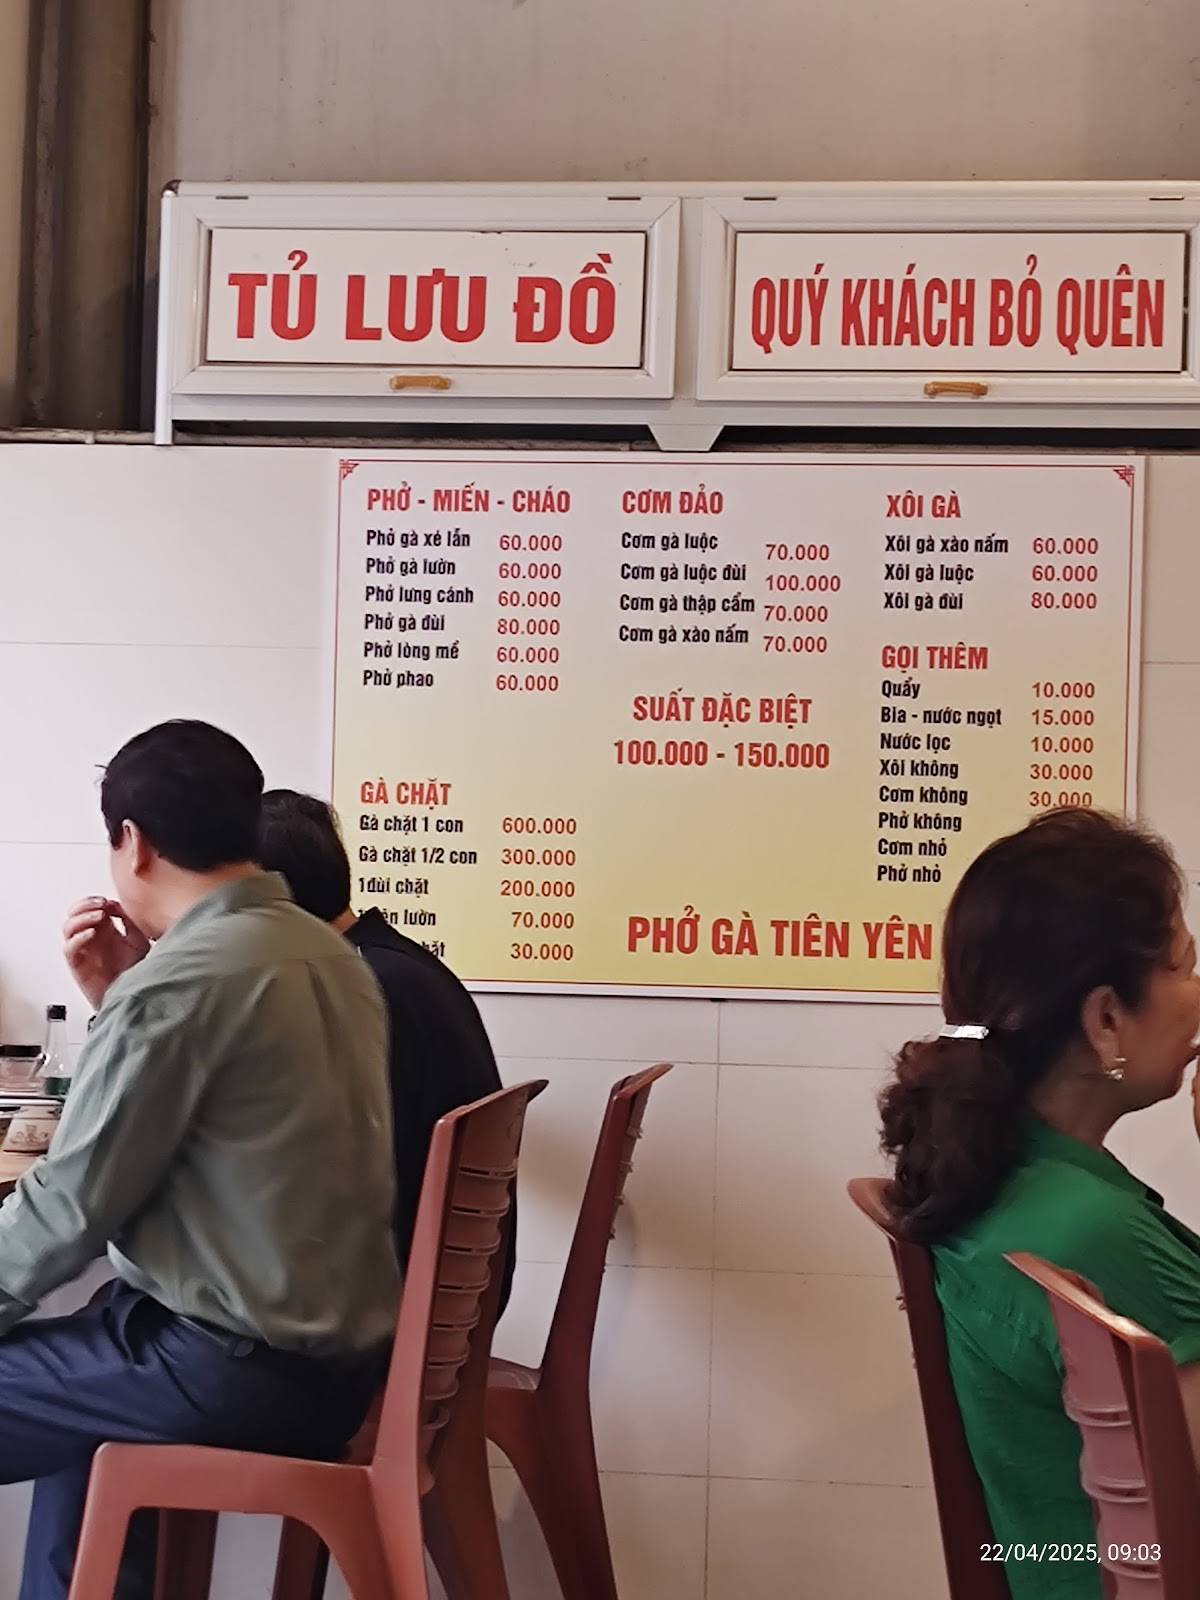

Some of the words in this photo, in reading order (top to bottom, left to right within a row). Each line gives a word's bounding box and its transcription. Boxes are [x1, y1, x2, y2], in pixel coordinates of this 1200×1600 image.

[228, 249, 318, 341] TỦ
[345, 267, 487, 343] LƯU
[513, 252, 617, 345] ĐỒ
[751, 263, 829, 355] QUÝ
[840, 263, 976, 347] KHÁCH
[989, 254, 1043, 348] BỎ
[1056, 263, 1165, 355] QUÊN
[367, 481, 412, 511] PHỞ
[433, 481, 490, 513] MIẾN
[512, 485, 570, 513] CHÁO
[622, 489, 672, 514] CƠM
[679, 483, 724, 515] ĐẢO
[886, 490, 924, 518] XÔI
[931, 490, 961, 518] GÀ
[366, 527, 395, 547] Phở
[400, 530, 418, 548] gà
[423, 530, 442, 547] xé
[499, 535, 563, 552] 60.000
[621, 531, 655, 549] Cơm
[661, 532, 679, 551] gà
[685, 533, 718, 552] luộc
[885, 534, 911, 552] Xôi
[916, 536, 935, 554] gà
[940, 537, 969, 553] xào
[974, 533, 1009, 553] nấm
[1032, 537, 1099, 555] 60.000
[766, 544, 830, 561] 70.000
[365, 555, 394, 574] Phở
[400, 558, 418, 577] gà
[423, 557, 456, 575] lườn
[499, 562, 562, 580] 60.000
[620, 563, 654, 580] Cơm
[660, 564, 678, 582] gà
[684, 564, 717, 584] luộc
[722, 563, 747, 581] đùi
[884, 563, 910, 581] Xôi
[915, 565, 934, 583] gà
[940, 564, 974, 585] luộc
[1032, 565, 1098, 582] 60.000
[765, 575, 841, 592] 100.000
[365, 584, 394, 602] Phở
[399, 586, 432, 605] lưng
[437, 586, 474, 603] cánh
[498, 591, 561, 608] 60.000
[620, 594, 654, 611] Cơm
[659, 594, 677, 613] gà
[683, 594, 716, 615] thập
[722, 592, 755, 612] cẩm
[884, 592, 909, 609] Xôi
[914, 593, 933, 611] gà
[939, 592, 963, 610] đùi
[1031, 592, 1098, 610] 80.000
[364, 611, 393, 631] Phở
[398, 614, 416, 632] gà
[421, 613, 445, 631] đùi
[764, 605, 828, 622] 70.000
[497, 618, 560, 635] 80.000
[619, 625, 653, 642] Cơm
[658, 625, 676, 644] gà
[682, 627, 710, 643] xào
[715, 623, 749, 643] nấm
[364, 639, 392, 658] Phở
[397, 642, 430, 660] lòng
[496, 646, 559, 664] 60.000
[763, 636, 827, 653] 70.000
[881, 645, 918, 673] GỌI
[926, 642, 988, 670] THÊM
[363, 667, 392, 687] Phở
[396, 670, 434, 689] phao
[496, 675, 559, 691] 60.000
[1032, 682, 1095, 699] 10.000
[633, 688, 695, 722] SUẤT
[702, 693, 751, 728] ĐẶC
[759, 693, 812, 729] BIỆT
[923, 708, 962, 724] nước
[967, 709, 1002, 729] ngọt
[1031, 709, 1095, 726] 15.000
[880, 733, 921, 750] Nước
[926, 735, 951, 754] lọc
[1031, 737, 1094, 753] 10.000
[613, 740, 708, 766] 100.000
[734, 743, 830, 769] 150.000
[880, 759, 906, 777] Xôi
[910, 759, 959, 780] không
[1030, 764, 1093, 781] 30.000
[360, 776, 389, 804] GÀ
[396, 777, 452, 810] CHẶT
[879, 785, 914, 803] Cơm
[919, 786, 968, 806] không
[1029, 791, 1092, 808] 30.000
[360, 814, 378, 831] Gà
[384, 815, 417, 836] chặt
[422, 816, 429, 832] 1
[435, 819, 463, 833] con
[502, 817, 577, 835] 600.000
[878, 810, 909, 829] Phở
[913, 812, 962, 832] không
[359, 846, 378, 863] Gà
[383, 846, 416, 867] chặt
[422, 847, 445, 865] 1/2
[450, 851, 478, 865] con
[501, 849, 576, 866] 300.000
[878, 838, 913, 856] Cơm
[918, 837, 948, 857] nhỏ
[877, 863, 908, 882] Phở
[395, 878, 429, 898] chặt
[500, 879, 575, 898] 200.000
[404, 908, 436, 926] lườn
[511, 911, 575, 929] 70.000
[627, 904, 701, 954] PHỞ
[712, 910, 758, 956] GÀ
[770, 912, 849, 958] TIÊN
[863, 914, 932, 960] YÊN
[510, 943, 574, 961] 30.000
